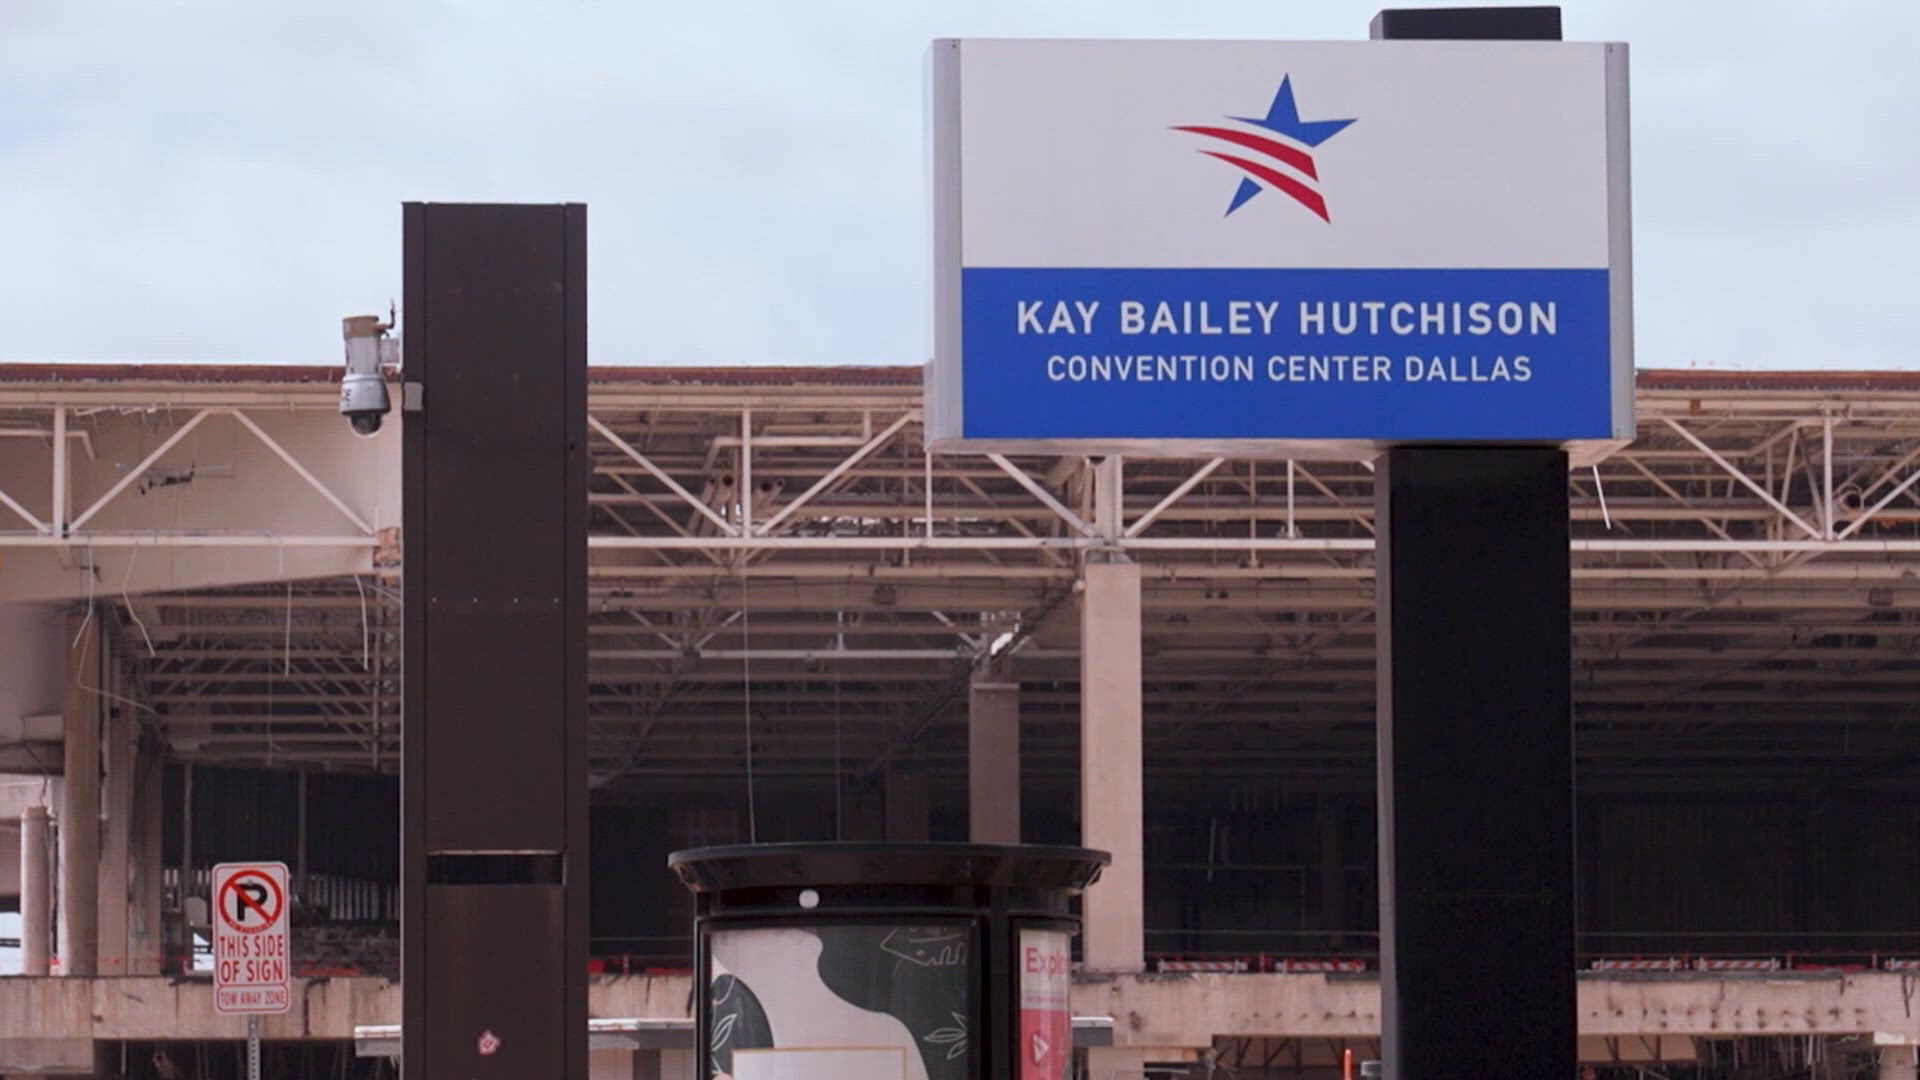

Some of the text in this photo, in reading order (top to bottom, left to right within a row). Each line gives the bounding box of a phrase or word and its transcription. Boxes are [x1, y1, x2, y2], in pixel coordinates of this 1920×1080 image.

[1018, 301, 1556, 335] KAY BAILEY HUTCHISON
[1047, 355, 1532, 381] CONVENTION CENTER DALLAS
[219, 935, 283, 957] THIS SIDE
[221, 960, 283, 982] OF SIGN
[220, 991, 237, 1005] TOW
[265, 990, 285, 1004] ZONE
